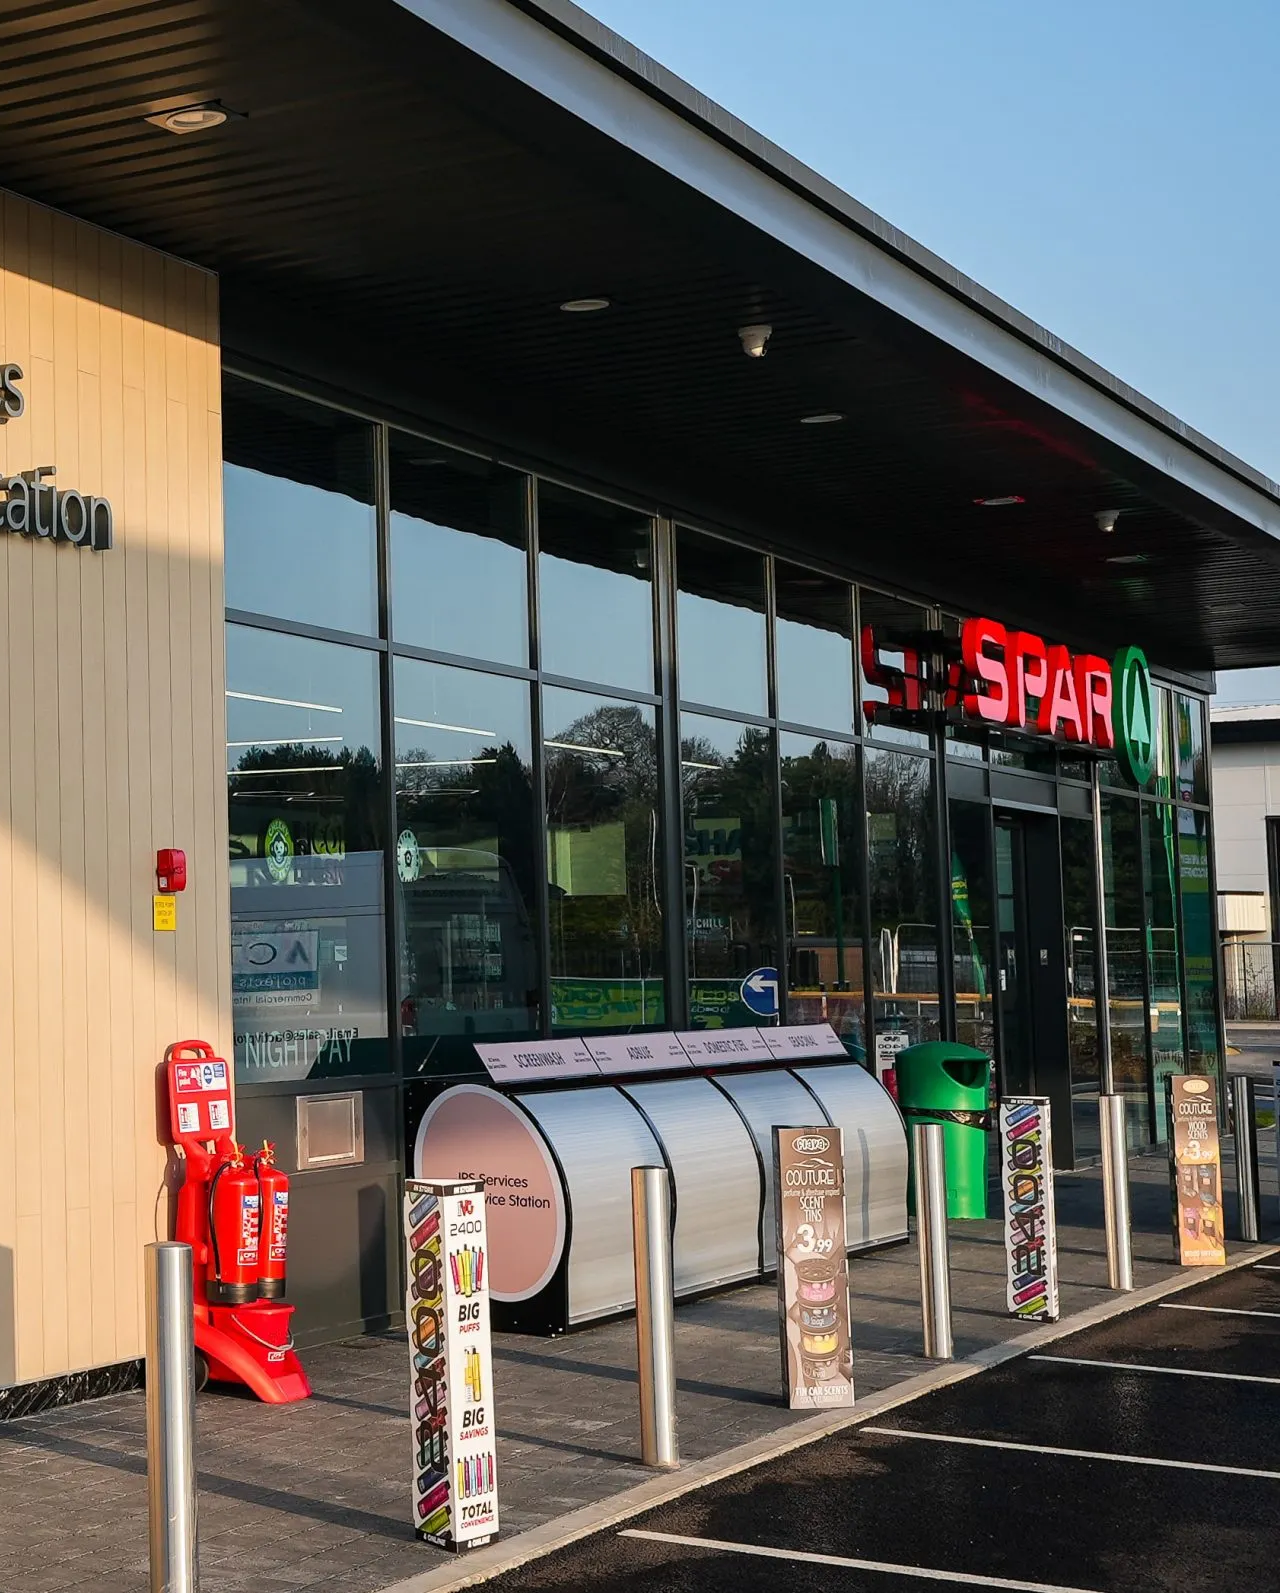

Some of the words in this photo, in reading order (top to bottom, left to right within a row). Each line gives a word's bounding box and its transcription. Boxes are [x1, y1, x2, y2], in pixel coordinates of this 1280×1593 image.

[962, 617, 1114, 749] SPAR
[245, 1029, 308, 1069] NIGHT
[317, 1027, 353, 1065] PAY
[513, 1052, 567, 1069] SCREENWASH
[1179, 1103, 1213, 1115] COUTURE
[1188, 1121, 1207, 1131] WOOD
[1187, 1130, 1208, 1140] SCENTS
[479, 1173, 528, 1188] Services
[786, 1169, 835, 1186] COUTURE
[508, 1195, 551, 1209] Station
[799, 1196, 825, 1210] SCENT
[804, 1209, 822, 1222] TINS
[450, 1220, 482, 1237] 2400
[458, 1302, 480, 1322] BIG
[459, 1322, 481, 1334] PUFFS
[808, 1386, 823, 1396] CAR
[824, 1385, 849, 1395] SCENTS
[462, 1407, 484, 1428] BIG
[460, 1426, 489, 1441] SAVINGS
[462, 1501, 493, 1520] TOTAL
